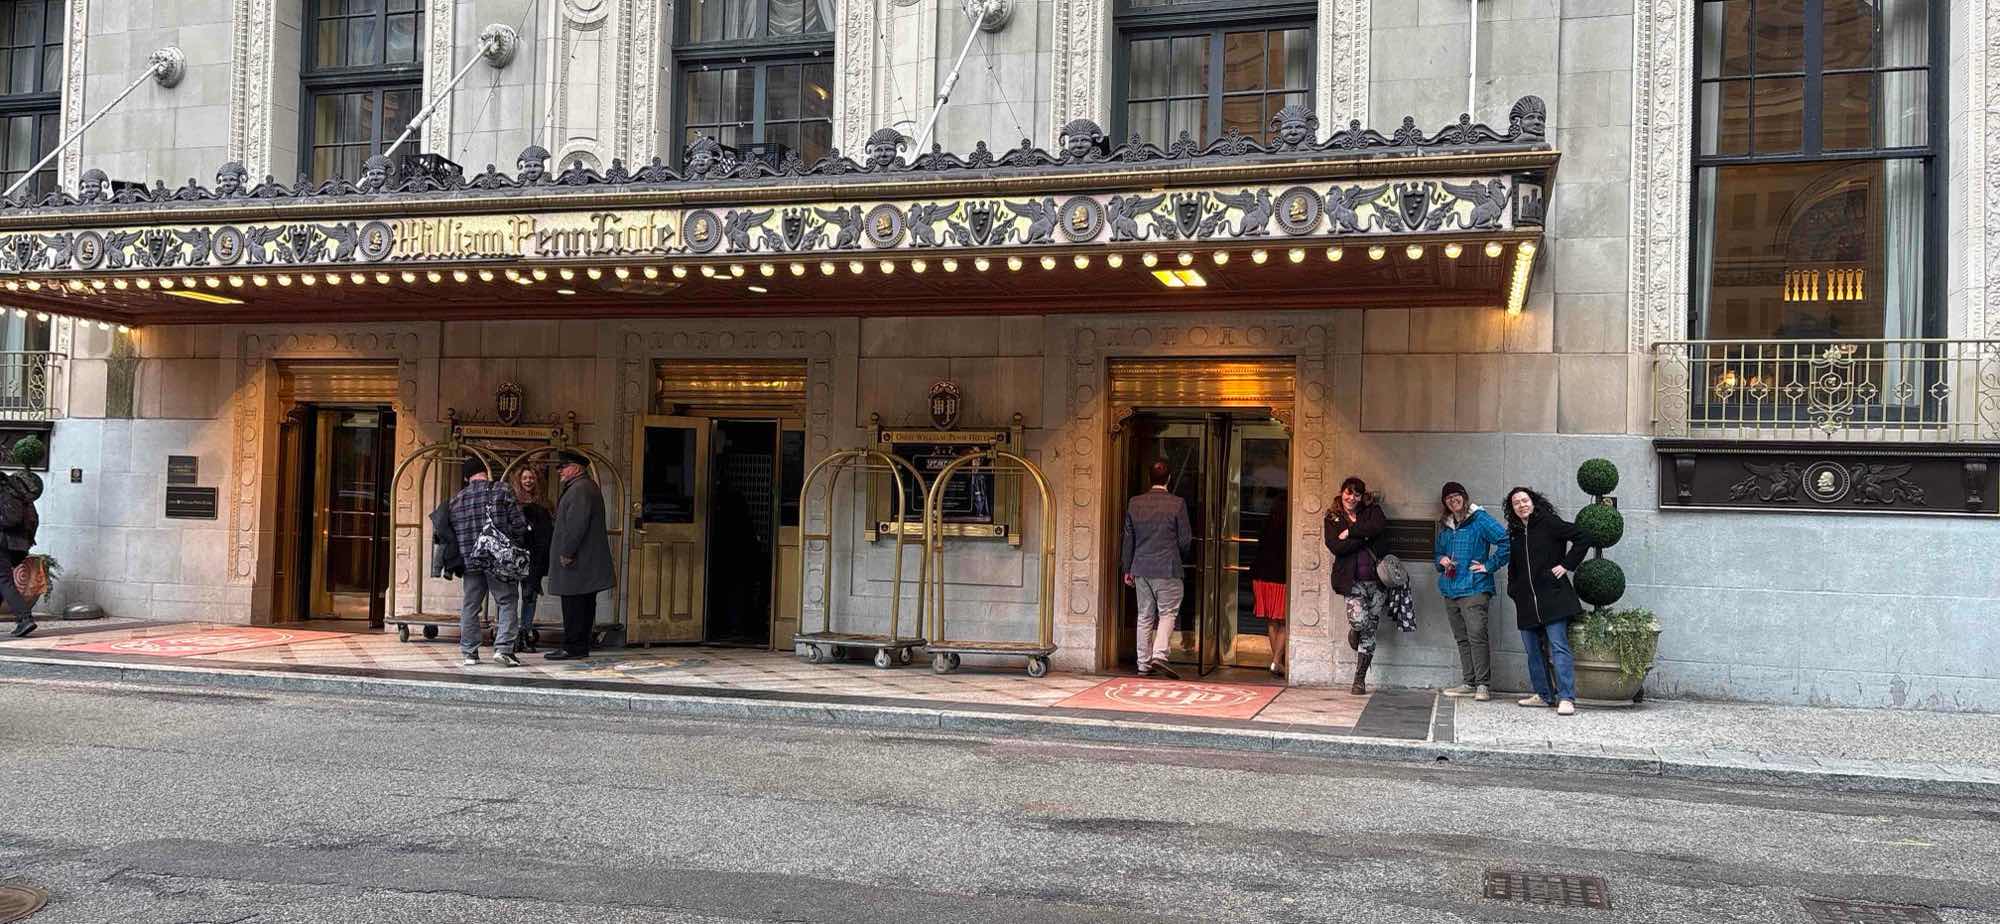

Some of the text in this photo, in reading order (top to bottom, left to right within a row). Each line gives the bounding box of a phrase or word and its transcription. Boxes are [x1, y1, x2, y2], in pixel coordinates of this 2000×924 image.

[391, 210, 685, 256] William Penn Hotel
